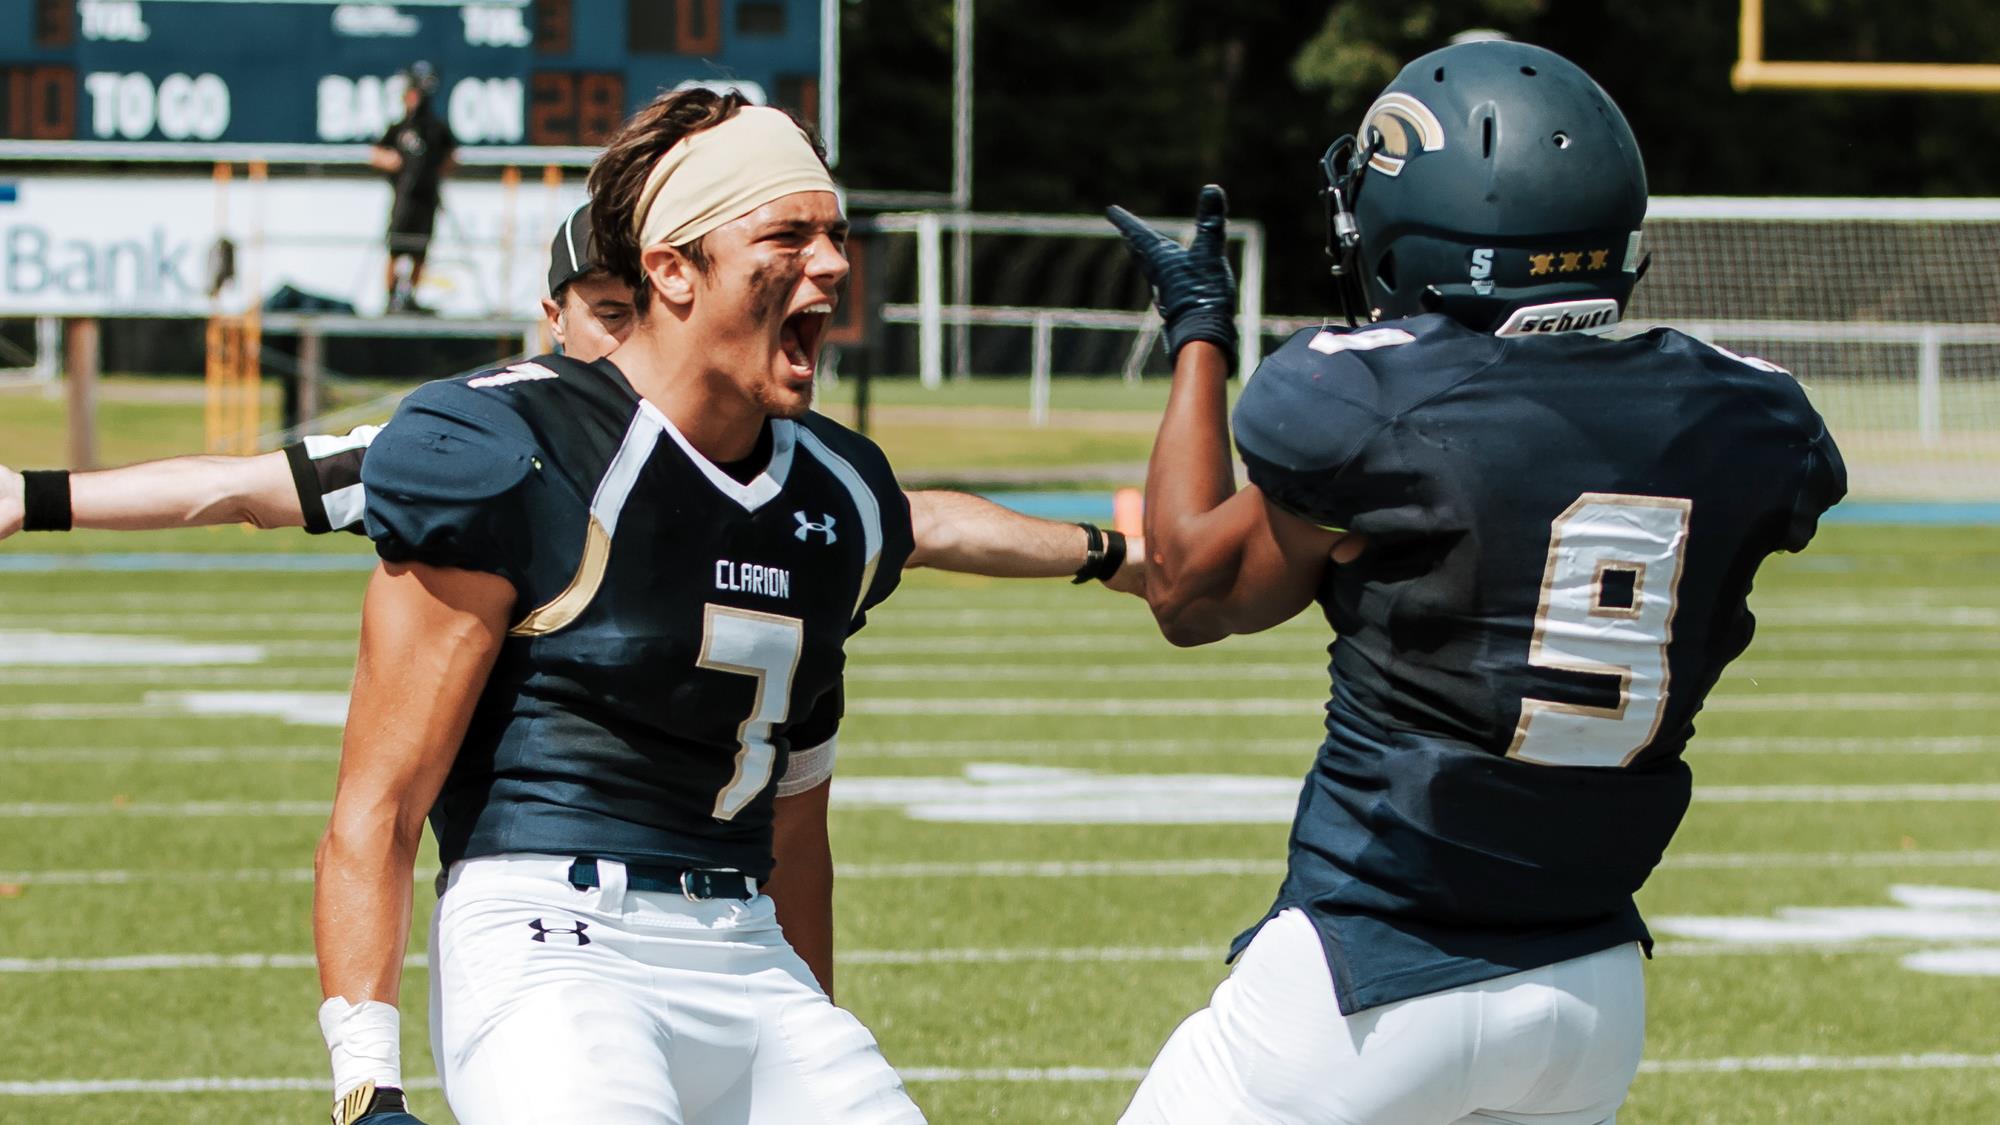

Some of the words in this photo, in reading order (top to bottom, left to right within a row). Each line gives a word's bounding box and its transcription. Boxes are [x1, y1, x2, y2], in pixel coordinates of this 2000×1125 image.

[85, 71, 154, 139] TO
[157, 73, 230, 140] GO
[448, 77, 524, 143] ON
[533, 70, 624, 146] 28
[5, 224, 193, 295] Bank
[1470, 248, 1494, 279] S
[715, 559, 790, 599] CLARION
[1505, 492, 1692, 767] 9
[697, 602, 803, 821] 7
